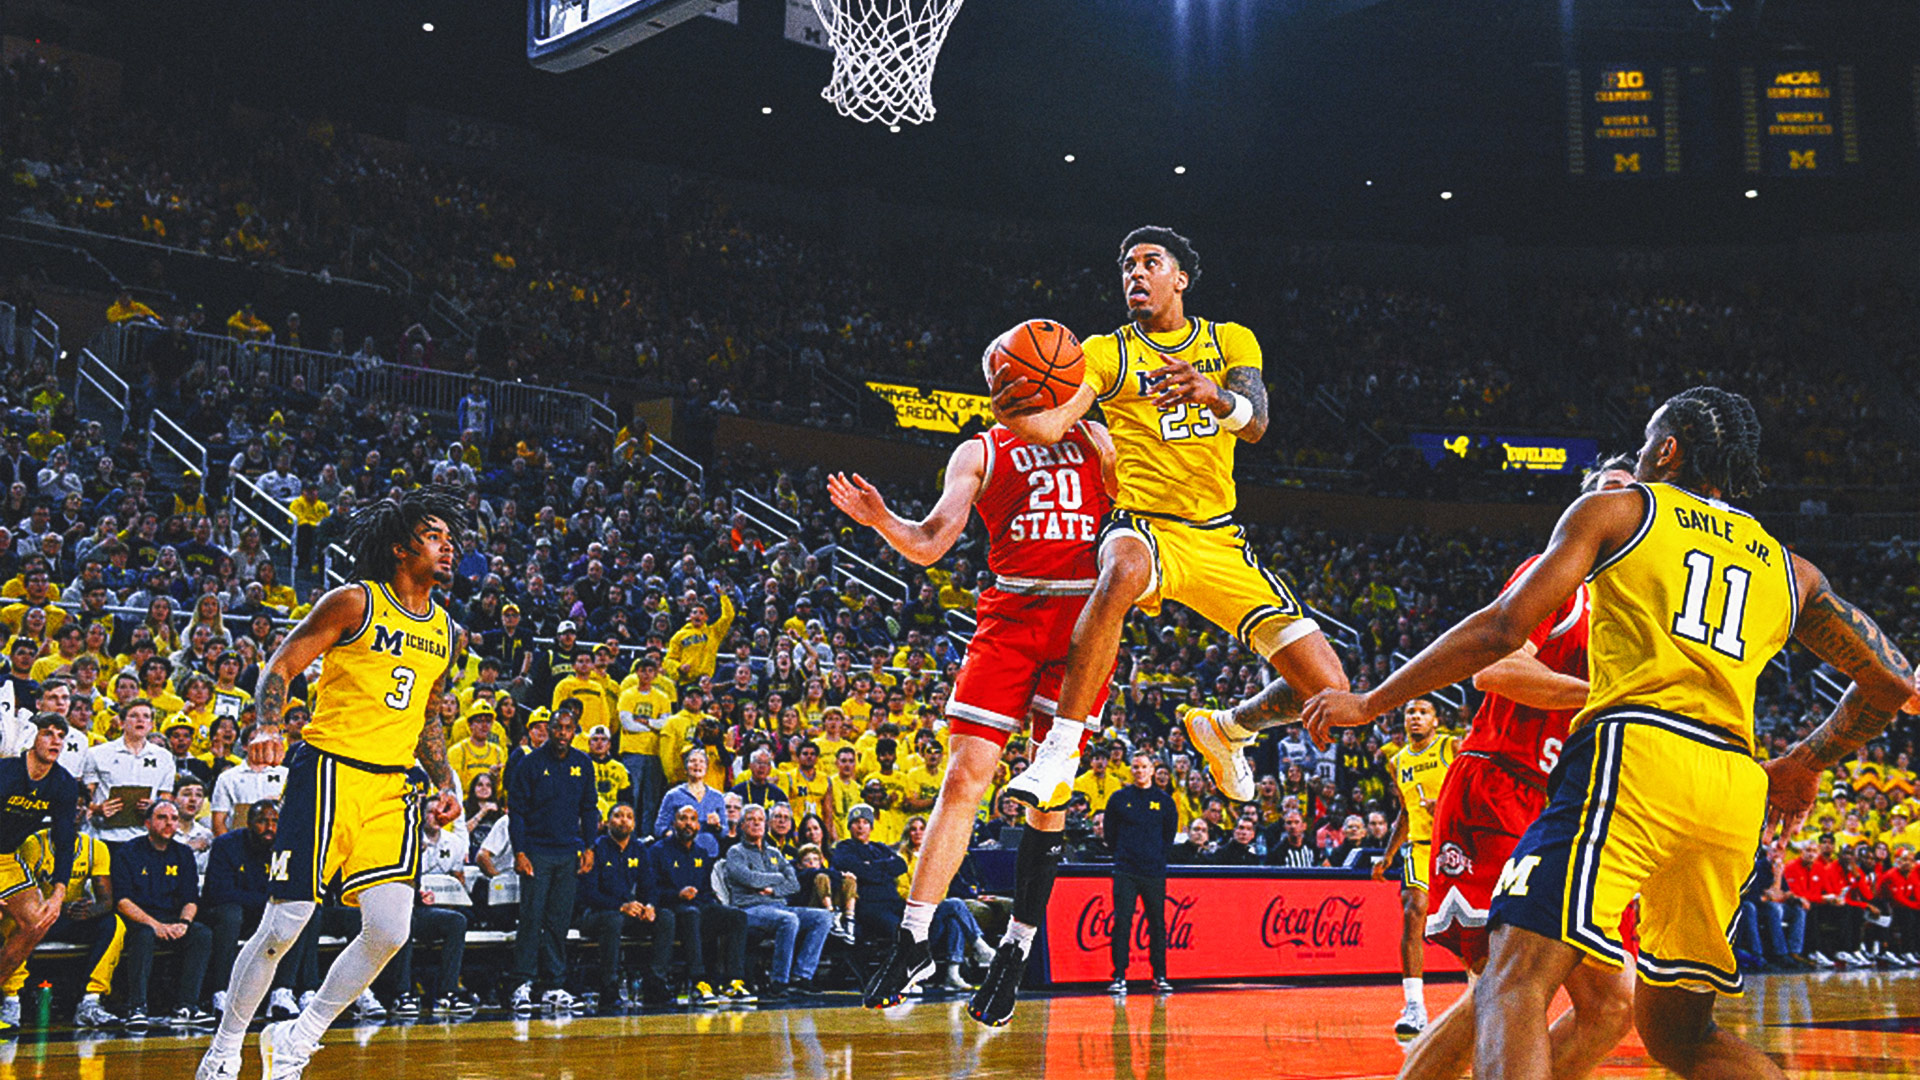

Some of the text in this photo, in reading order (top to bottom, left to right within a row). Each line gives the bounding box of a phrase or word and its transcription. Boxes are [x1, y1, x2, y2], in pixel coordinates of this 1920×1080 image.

[957, 397, 975, 411] OF
[1158, 402, 1220, 441] 23
[1009, 442, 1085, 473] OHIO
[1027, 468, 1083, 511] 20
[1010, 512, 1096, 542] STATE
[1674, 507, 1771, 567] GAYLE JR.
[1671, 548, 1752, 662] 11
[370, 624, 447, 659] MICHIGAN
[384, 665, 417, 711] 3
[1489, 855, 1542, 900] M
[1261, 895, 1364, 949] Coca-Cola
